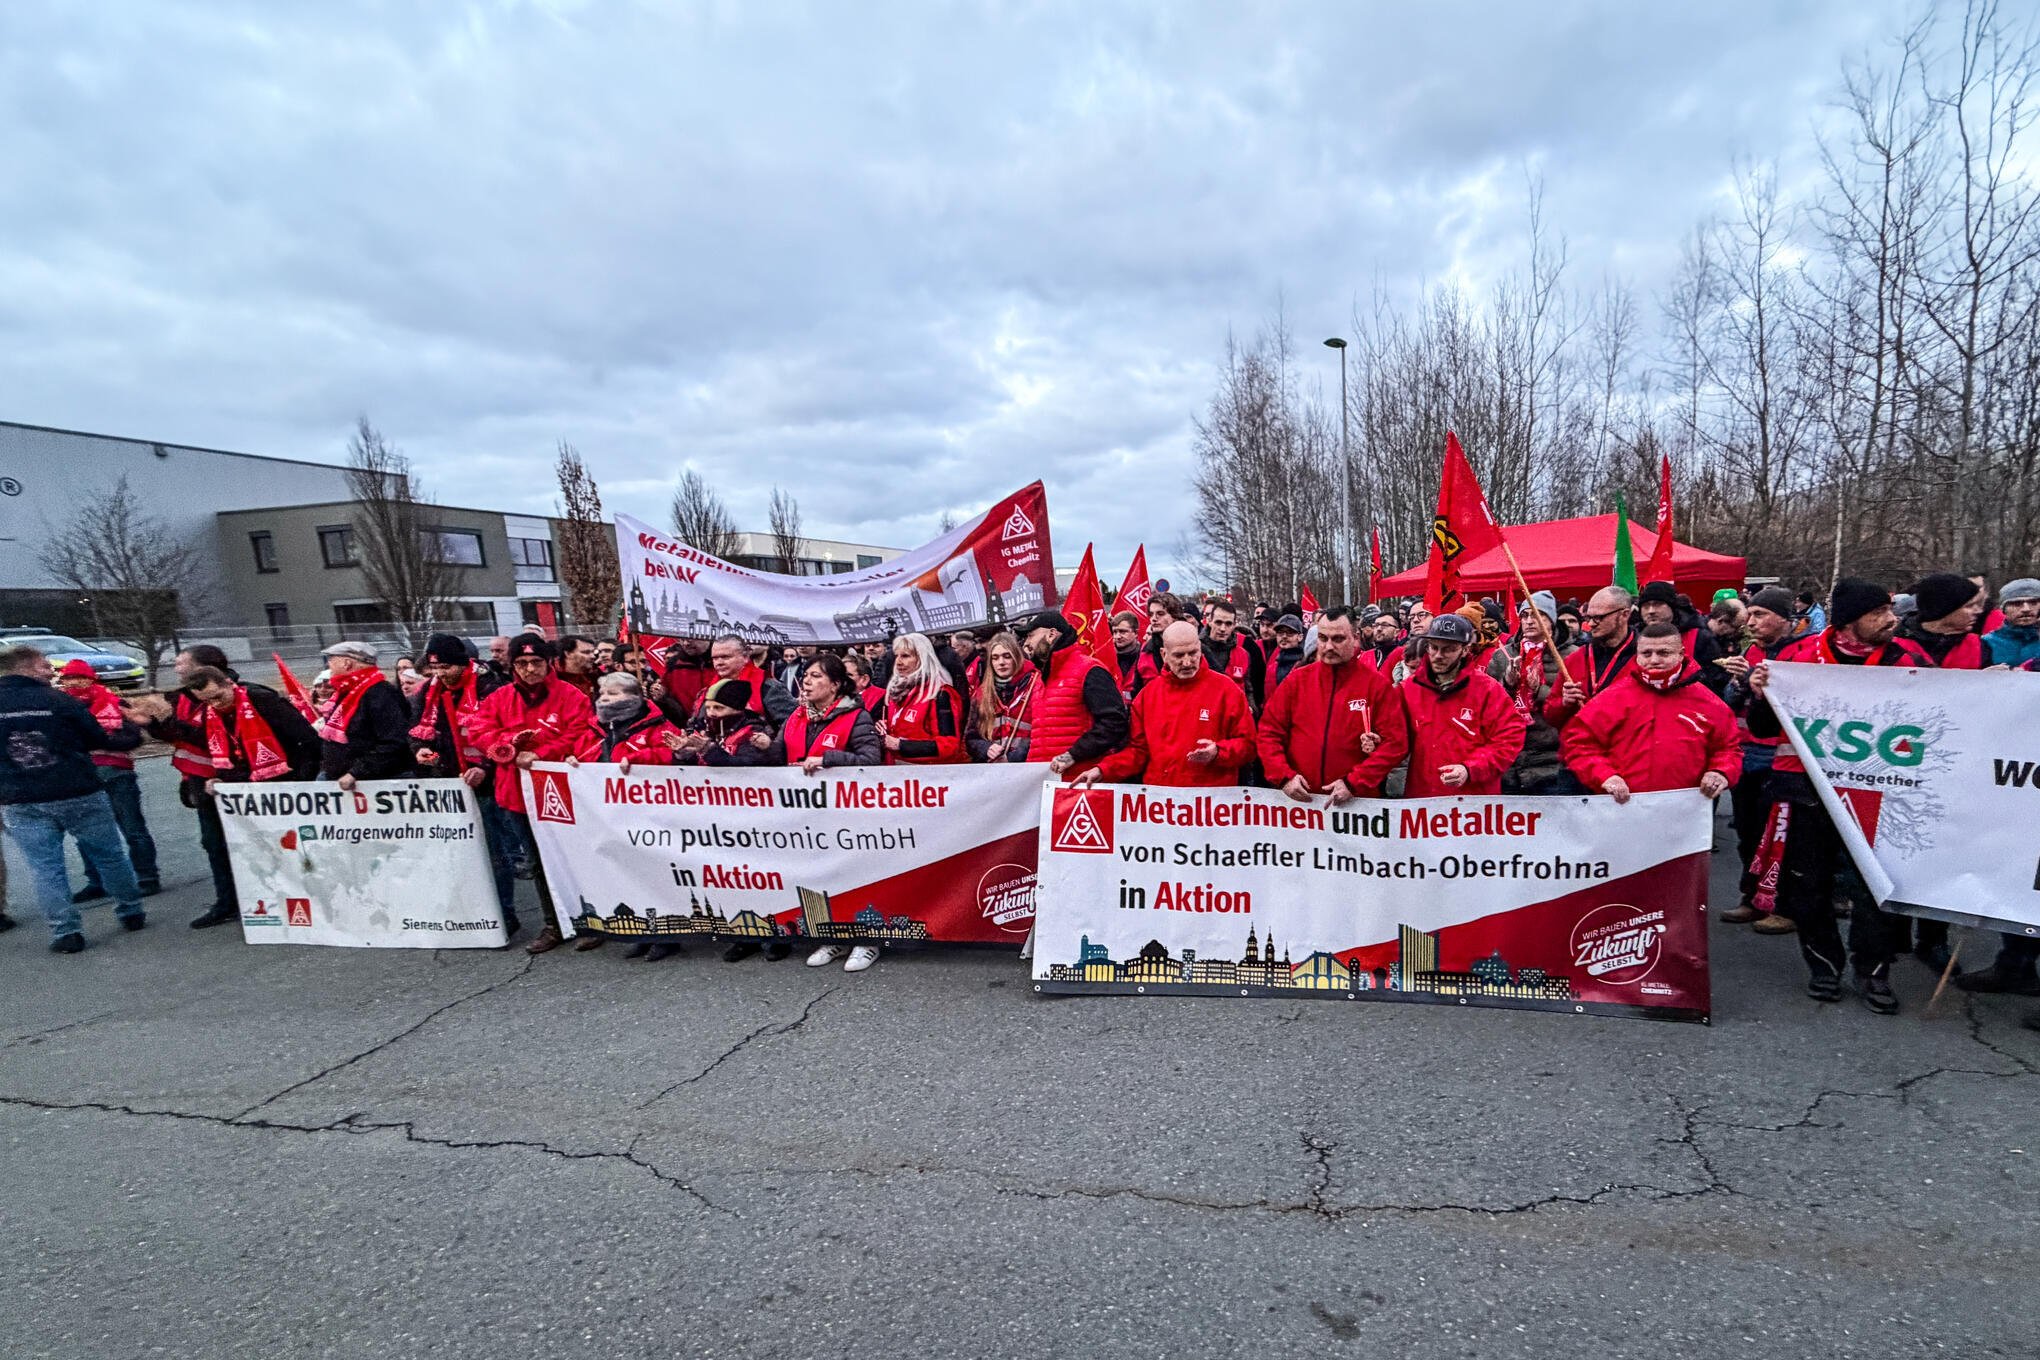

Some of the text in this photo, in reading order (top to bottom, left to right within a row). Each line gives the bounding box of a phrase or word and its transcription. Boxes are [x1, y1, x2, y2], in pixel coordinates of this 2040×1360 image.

[1792, 716, 1926, 767] KSG
[604, 777, 949, 809] Metallerinnen und Metaller
[1849, 771, 1923, 788] together
[220, 792, 343, 816] STANDORT
[354, 791, 369, 815] D
[1120, 793, 1542, 839] Metallerinnen und Metaller
[321, 823, 424, 844] Margenwahn
[628, 823, 916, 853] von pulsotronic GmbH
[1120, 842, 1609, 879] von Schaeffler Limbach-Oberfrohna
[671, 863, 784, 891] in Aktion
[1120, 879, 1251, 913] in Aktion
[445, 919, 500, 931] Chemnitz
[1582, 910, 1664, 940] WIR BAUEN UNSERE
[1601, 956, 1633, 970] SELBST
